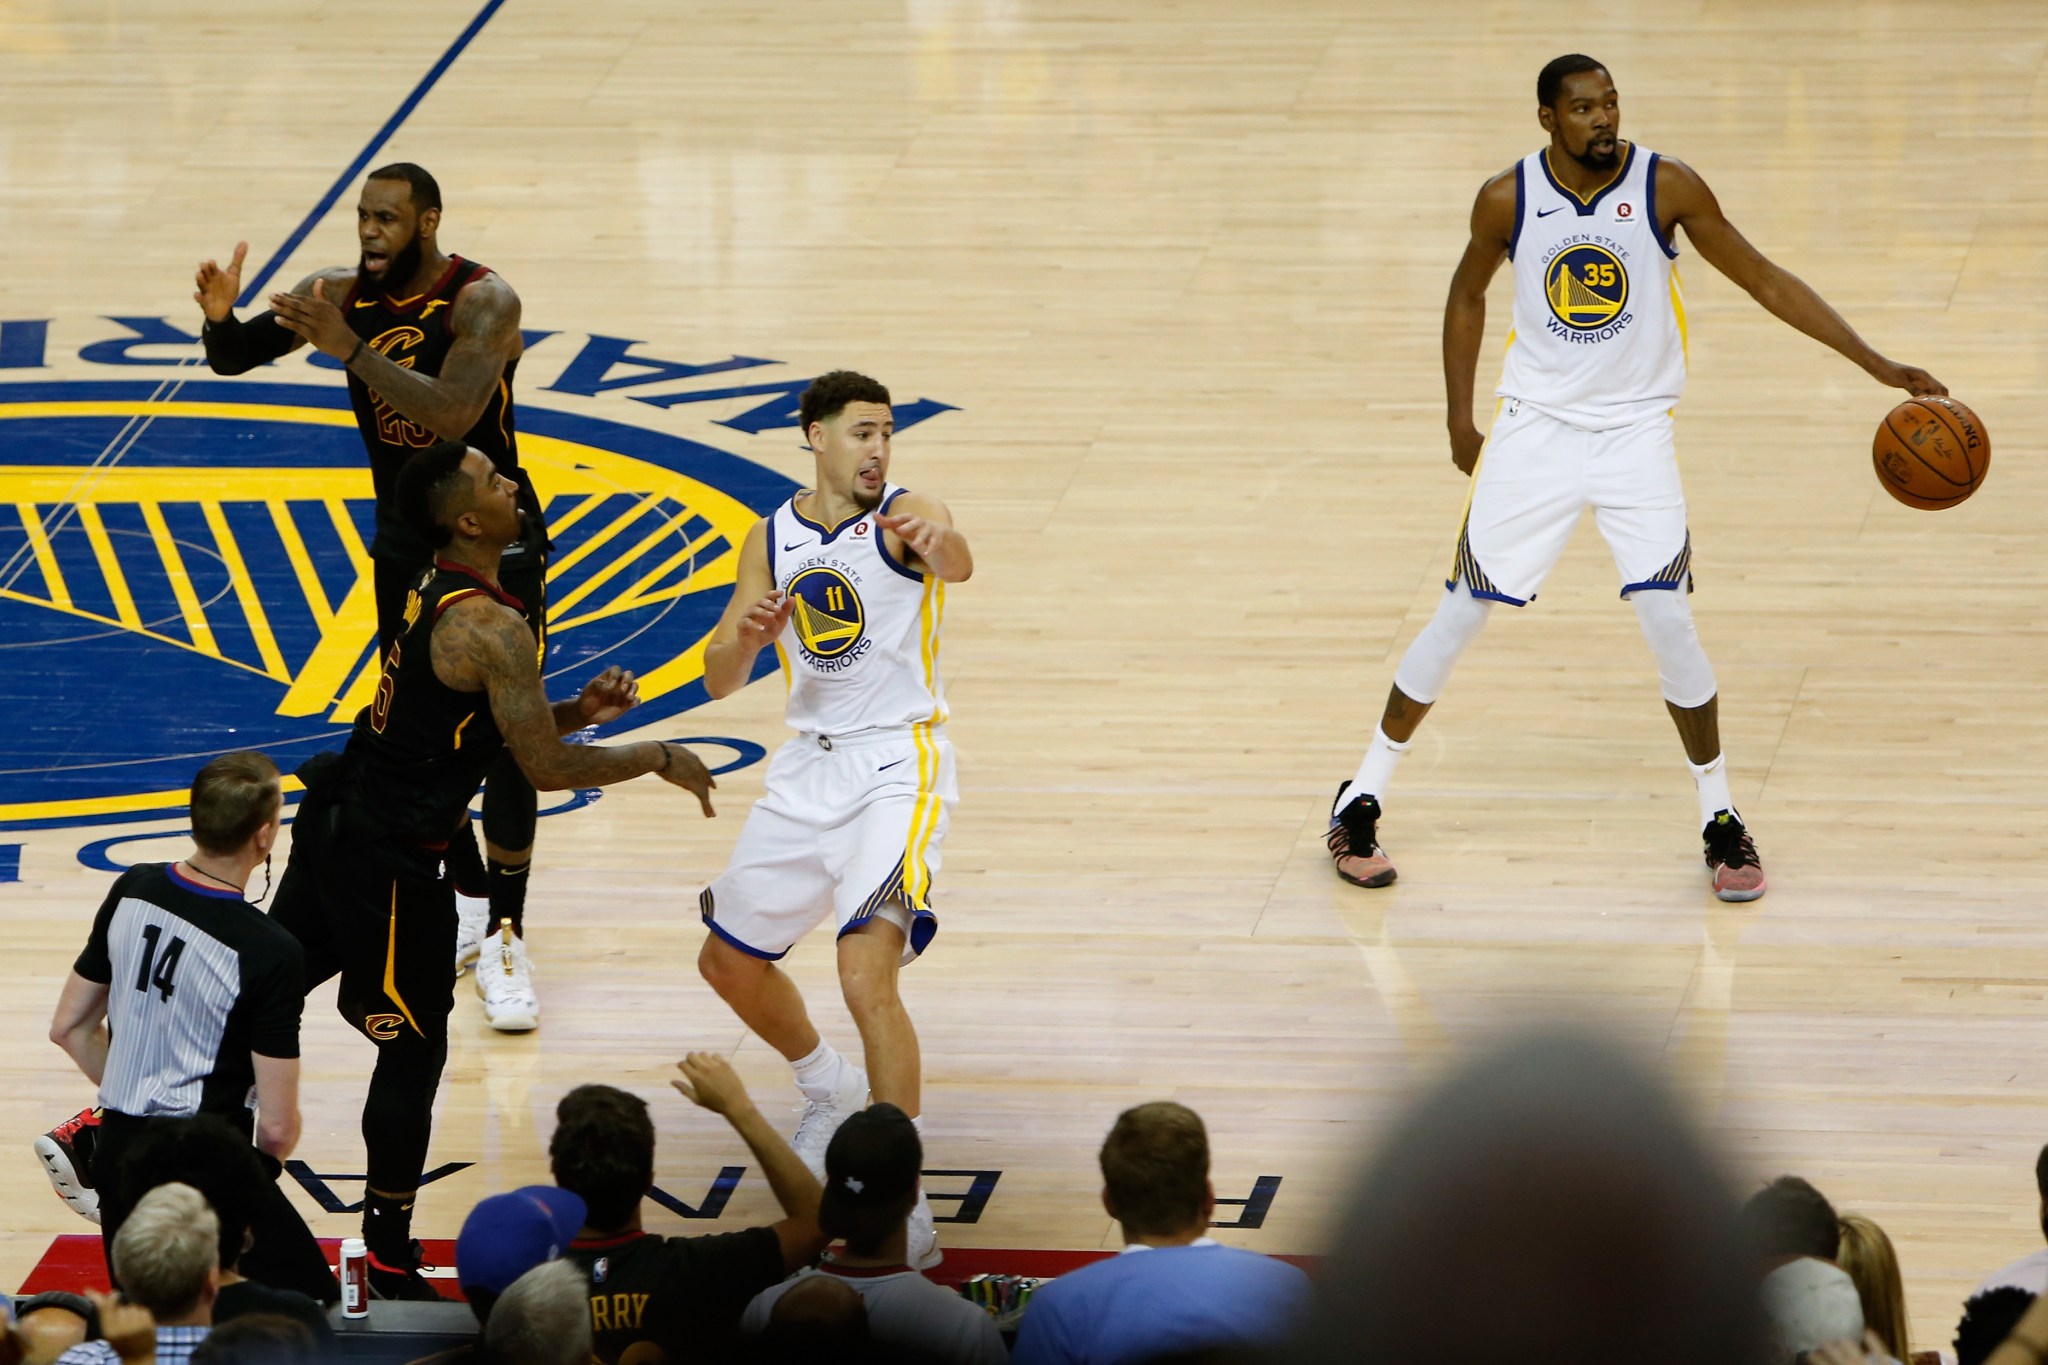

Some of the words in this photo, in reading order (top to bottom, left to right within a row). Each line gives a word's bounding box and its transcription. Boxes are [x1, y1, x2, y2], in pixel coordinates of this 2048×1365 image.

[1541, 234, 1590, 264] GOLDEN
[1595, 235, 1630, 260] STATE
[1583, 262, 1616, 287] 35
[1546, 311, 1633, 344] WARRIORS
[782, 558, 826, 590] GOLDEN
[831, 559, 863, 586] STATE
[826, 585, 845, 612] 11
[799, 636, 872, 673] WARRIORS
[136, 923, 187, 1004] 14
